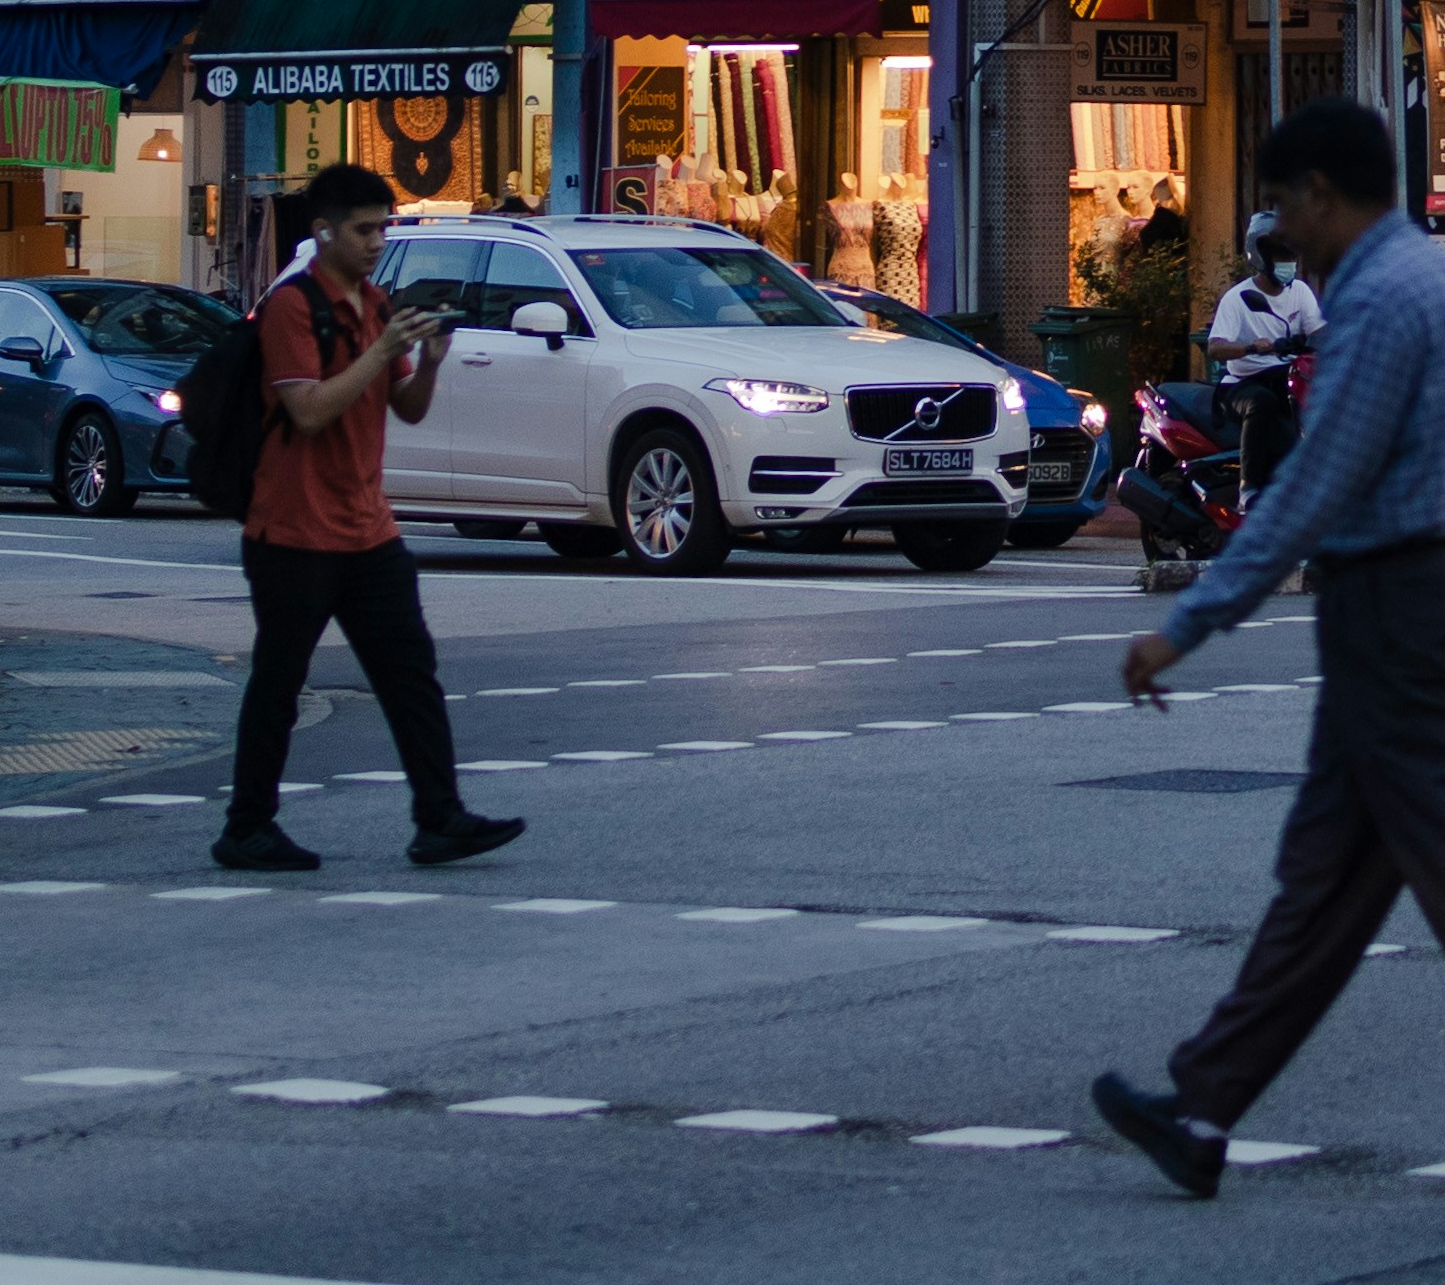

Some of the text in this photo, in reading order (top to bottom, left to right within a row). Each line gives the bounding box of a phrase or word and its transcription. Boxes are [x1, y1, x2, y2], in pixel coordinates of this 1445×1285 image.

[1076, 50, 1090, 60] 119
[1102, 34, 1171, 57] ASHER
[1184, 51, 1198, 62] 119
[1102, 60, 1172, 74] FABRICS
[210, 62, 495, 94] 115 ALIBABA TEXTILES 115
[627, 89, 677, 110] Tailoring
[1153, 87, 1198, 98] VELVETS
[628, 115, 675, 132] Services
[306, 101, 321, 173] AILOR
[625, 139, 677, 158] Available
[889, 451, 972, 470] SLT7684H
